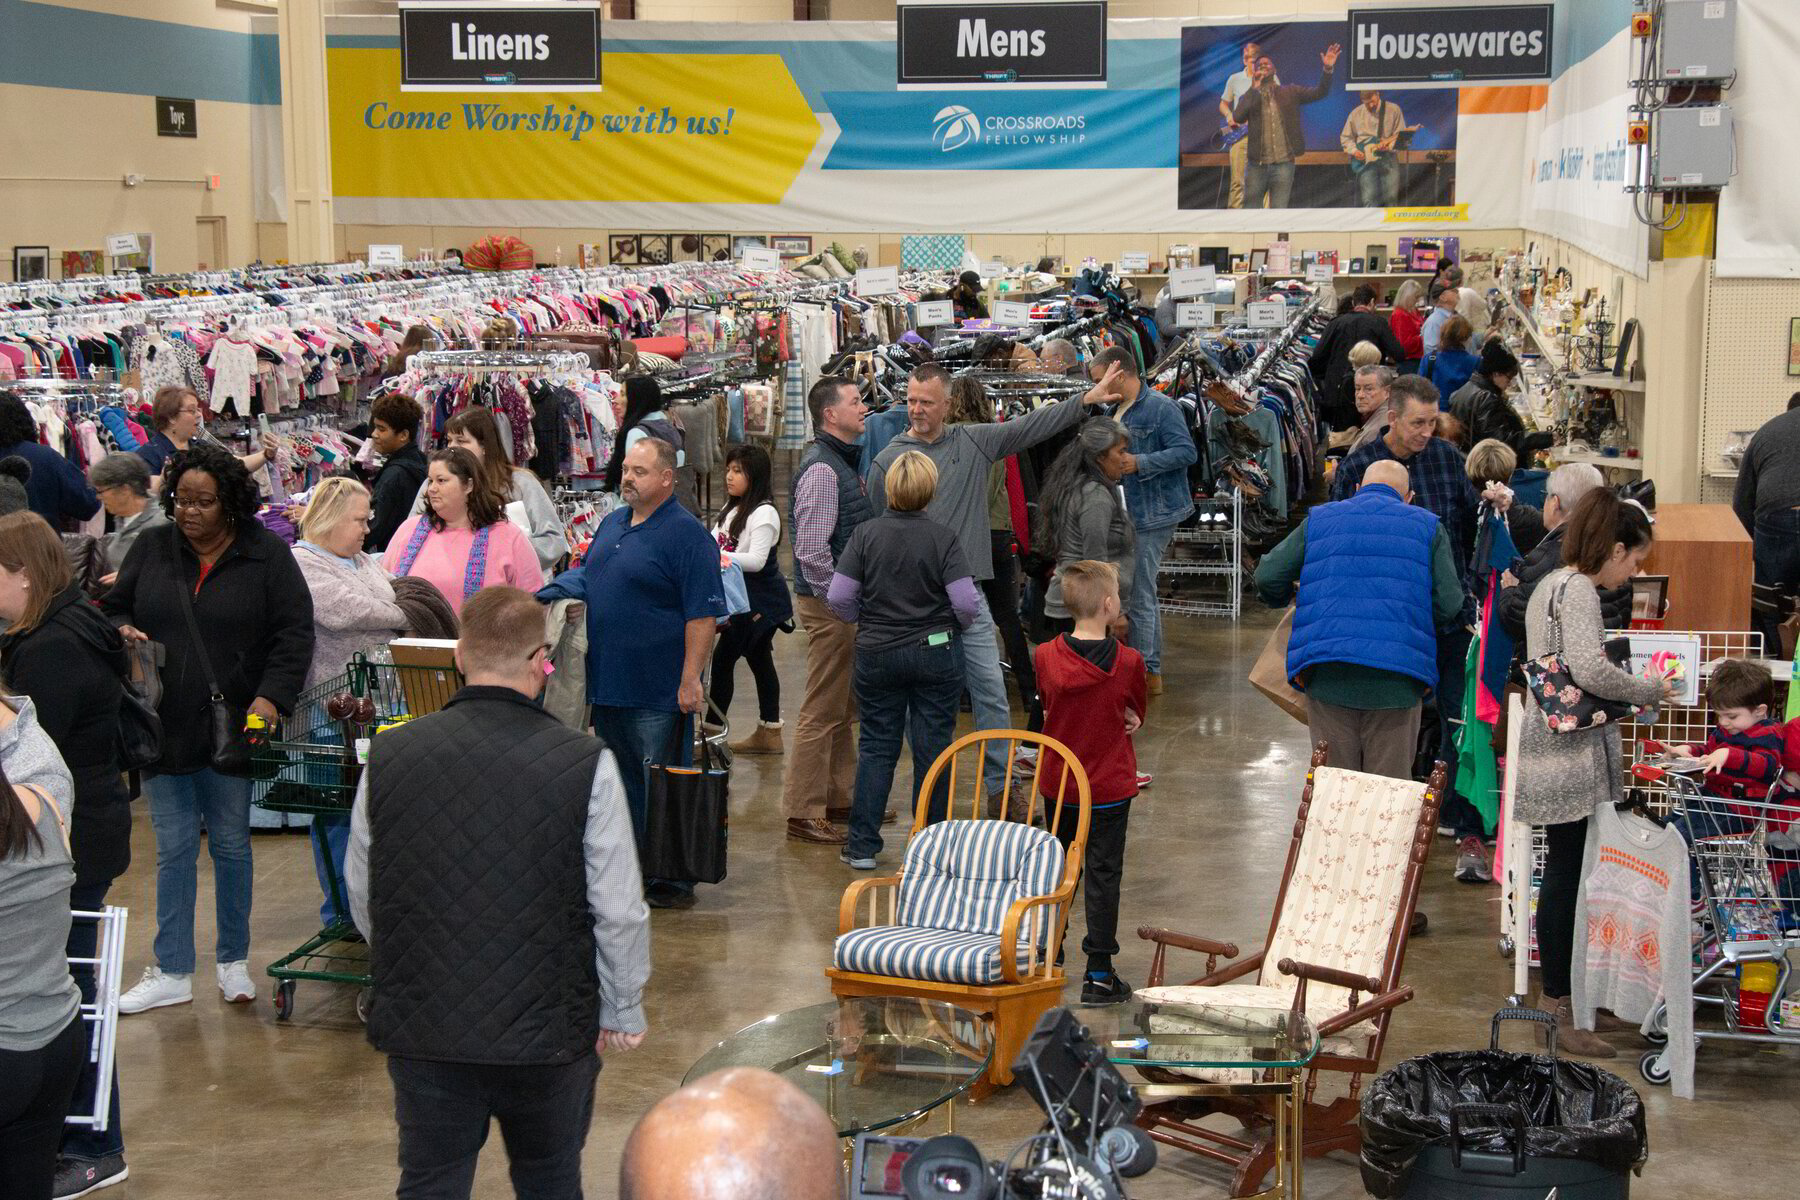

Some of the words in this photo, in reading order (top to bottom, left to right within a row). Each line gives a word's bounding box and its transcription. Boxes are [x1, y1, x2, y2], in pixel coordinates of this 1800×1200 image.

[451, 22, 549, 60] Linens
[957, 18, 1046, 57] Mens
[1356, 23, 1543, 60] Housewares
[169, 105, 185, 130] Toys
[364, 101, 452, 129] Come
[460, 104, 595, 141] Worship
[601, 106, 678, 134] with
[686, 107, 735, 135] us!
[985, 115, 1085, 130] CROSSROADS
[985, 133, 1086, 145] FELLOWSHIP
[1393, 210, 1461, 219] crossroads.org
